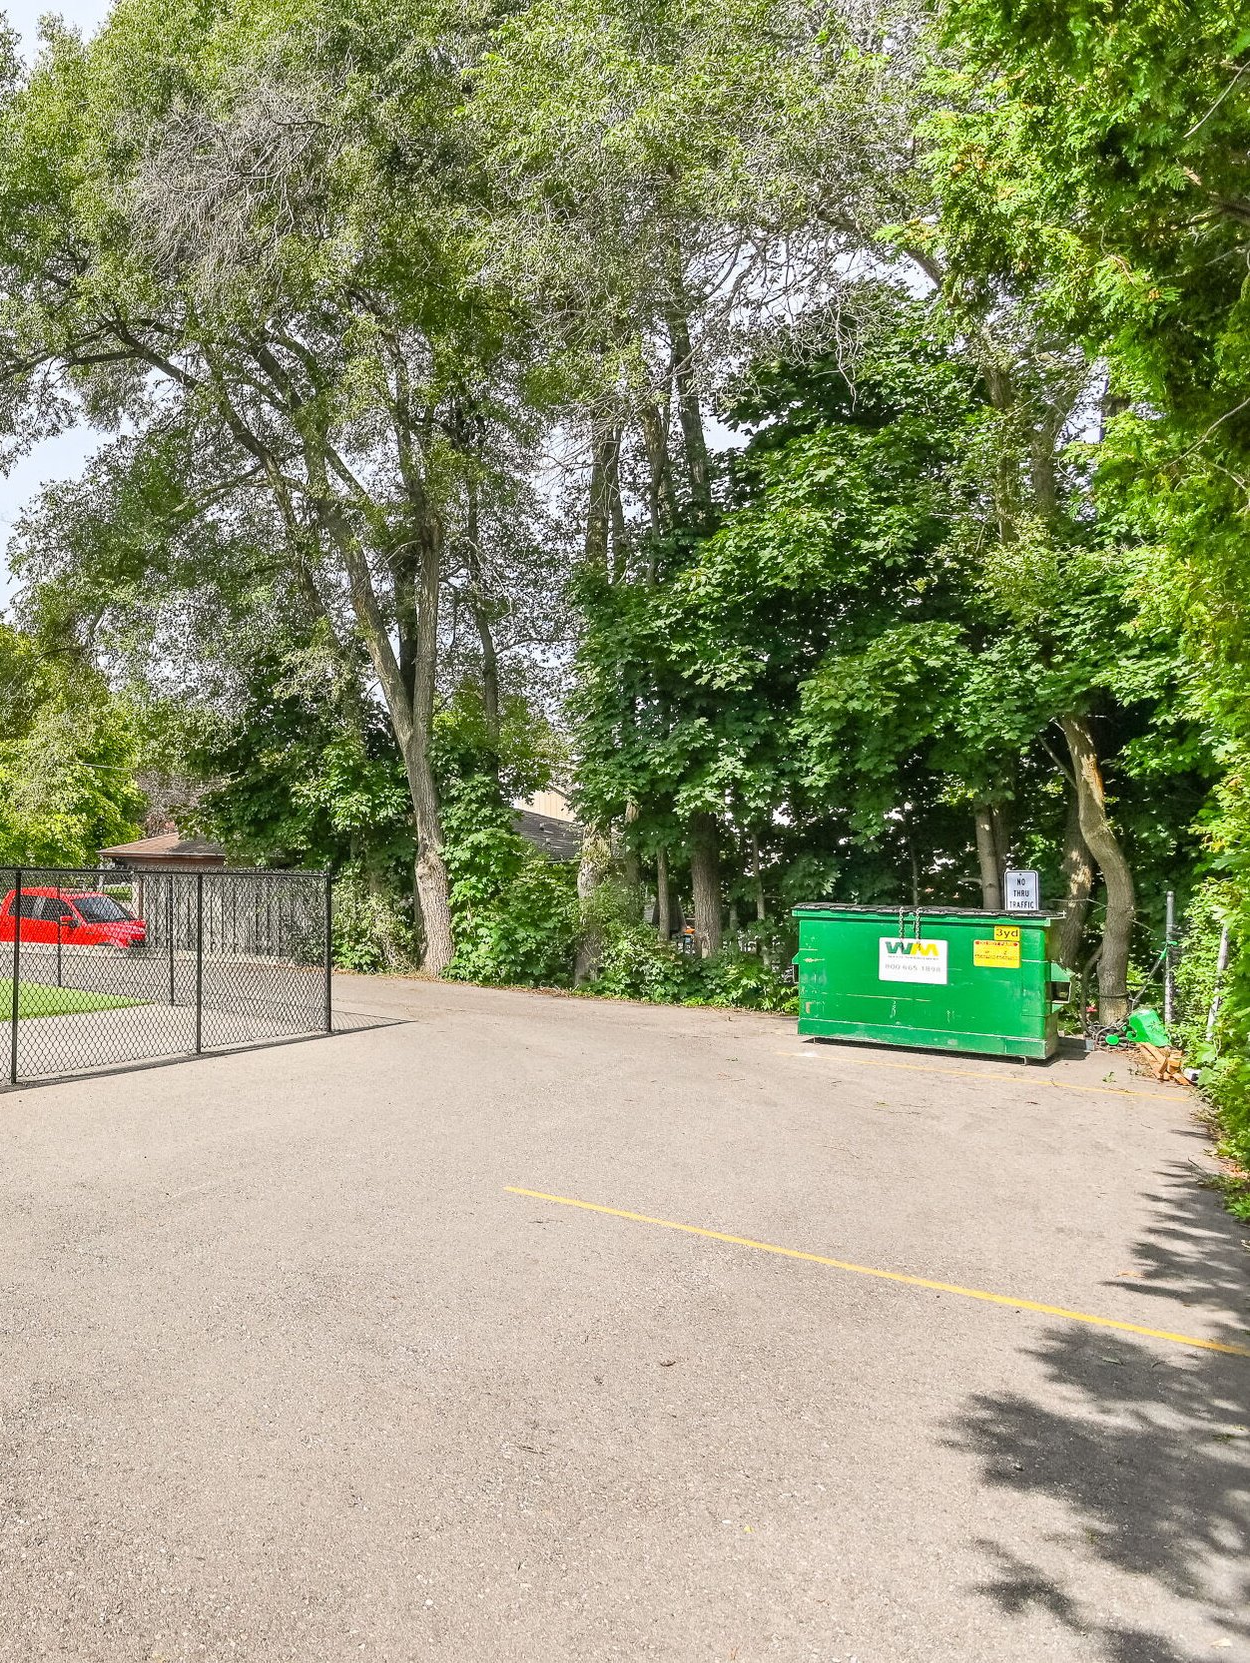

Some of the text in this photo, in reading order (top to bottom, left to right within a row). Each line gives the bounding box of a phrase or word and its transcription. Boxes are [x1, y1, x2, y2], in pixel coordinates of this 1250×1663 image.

[1016, 878, 1026, 886] NO
[1013, 889, 1030, 897] THRU
[1009, 900, 1034, 909] TRAFFIC
[996, 928, 1019, 939] 3yd
[885, 941, 939, 956] WM
